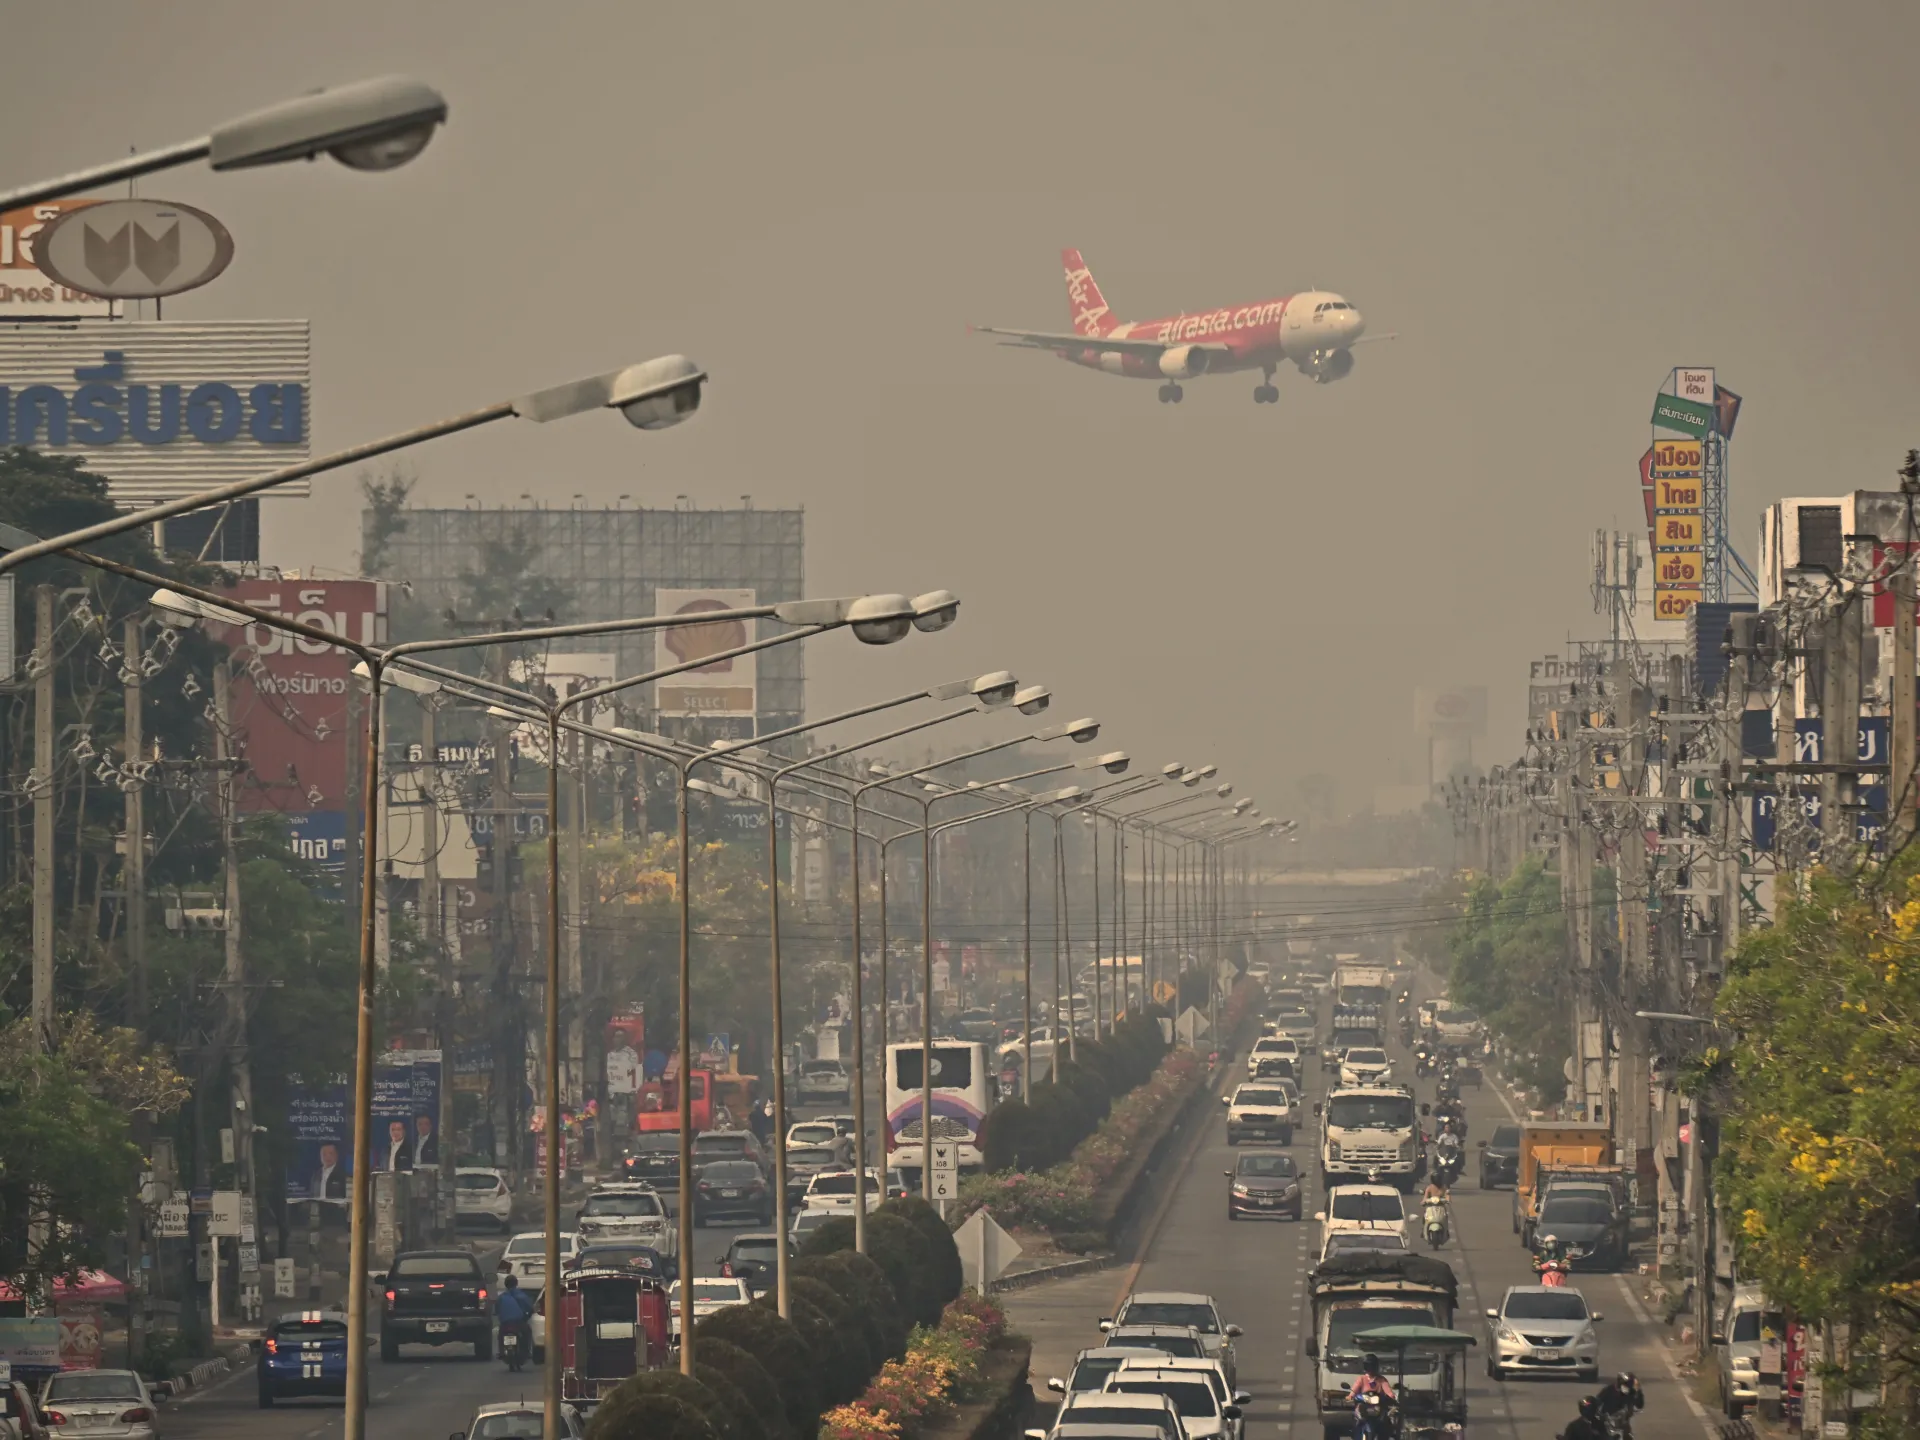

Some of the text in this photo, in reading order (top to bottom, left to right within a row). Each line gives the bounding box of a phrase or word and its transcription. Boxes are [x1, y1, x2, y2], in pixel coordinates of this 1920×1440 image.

[1158, 301, 1284, 342] airasia.com
[1655, 445, 1700, 466] เมือง
[1661, 482, 1697, 504] ไทย
[1666, 521, 1692, 539] สิน
[1662, 555, 1695, 579] เชื่อ
[683, 696, 728, 710] SELECT
[937, 1184, 947, 1195] 6
